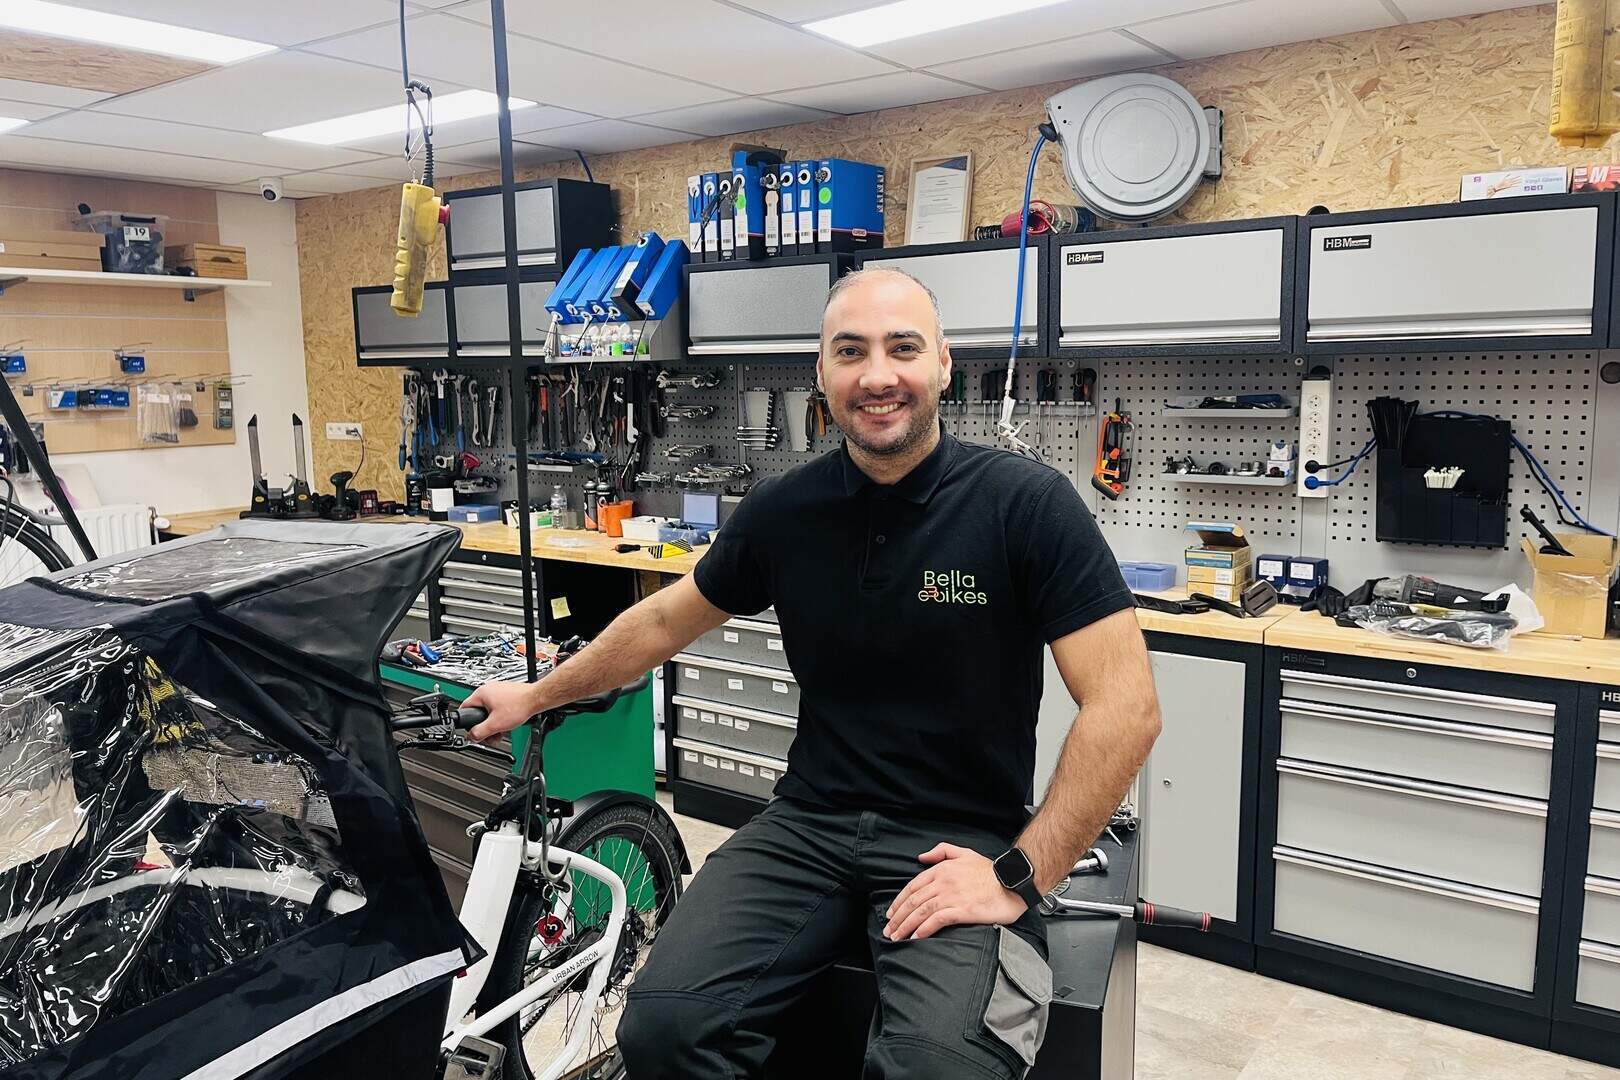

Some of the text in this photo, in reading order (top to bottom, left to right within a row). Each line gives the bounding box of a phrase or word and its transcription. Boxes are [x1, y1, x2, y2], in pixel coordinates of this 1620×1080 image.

[134, 227, 146, 236] 19
[924, 570, 975, 588] Bella
[552, 950, 599, 983] URBAN ARROW
